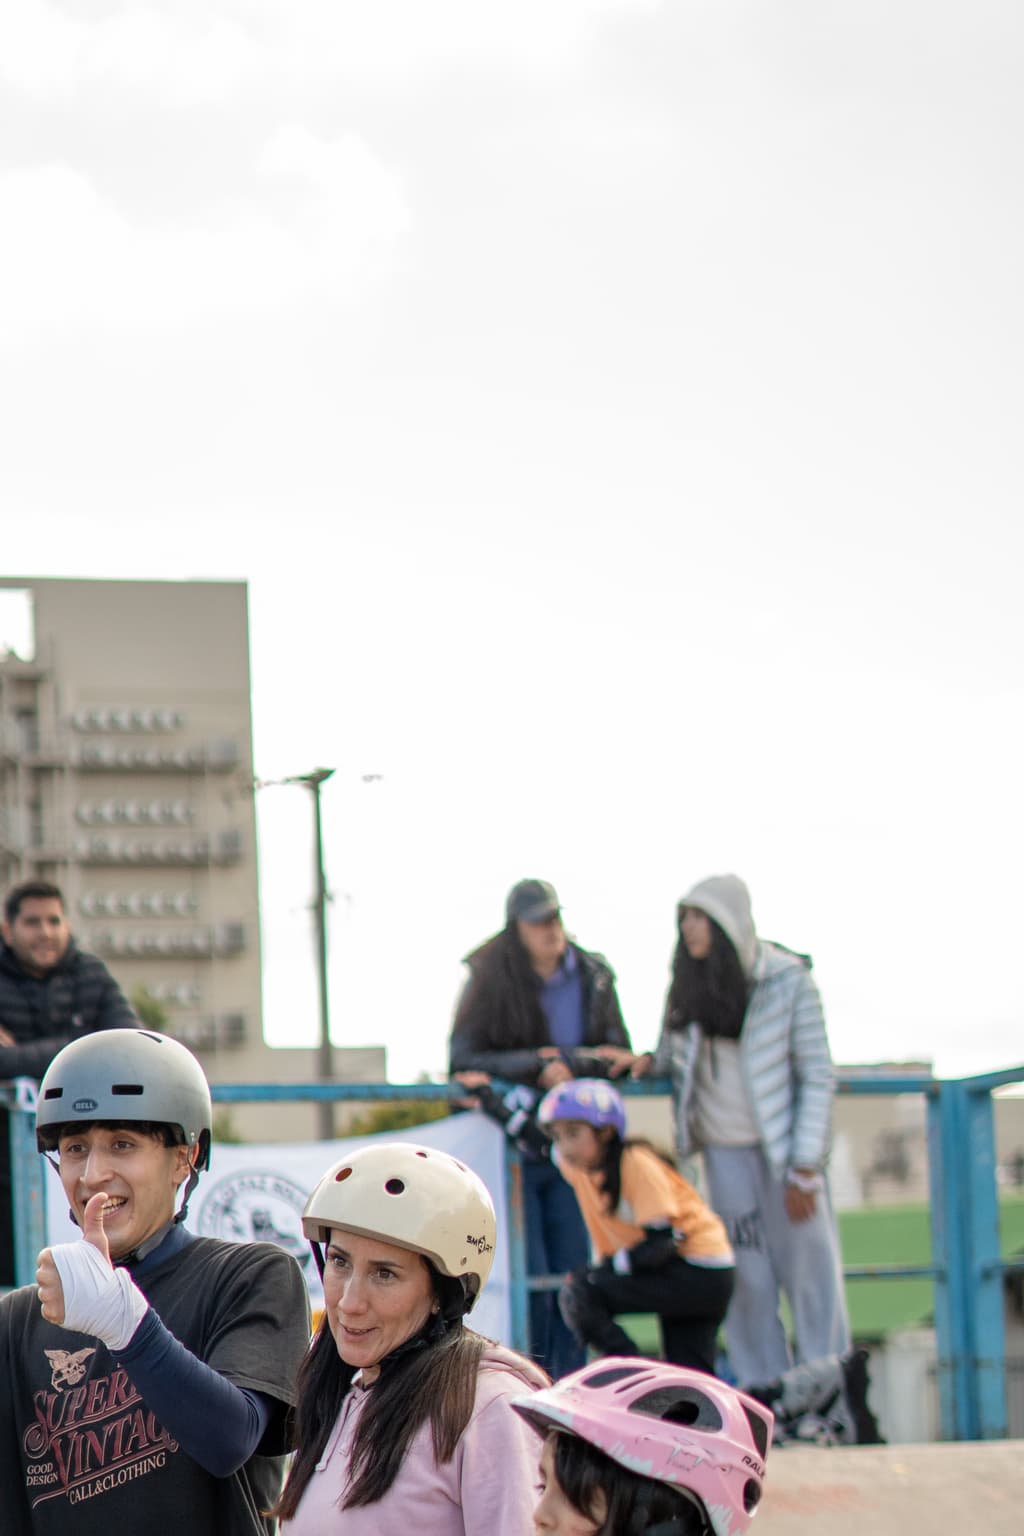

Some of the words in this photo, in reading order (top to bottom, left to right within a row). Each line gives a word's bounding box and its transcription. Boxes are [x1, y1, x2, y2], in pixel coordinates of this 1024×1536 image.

[27, 1463, 54, 1474] GOOD
[26, 1472, 59, 1487] DESIGN
[69, 1452, 167, 1505] CALL&CLOTHING
